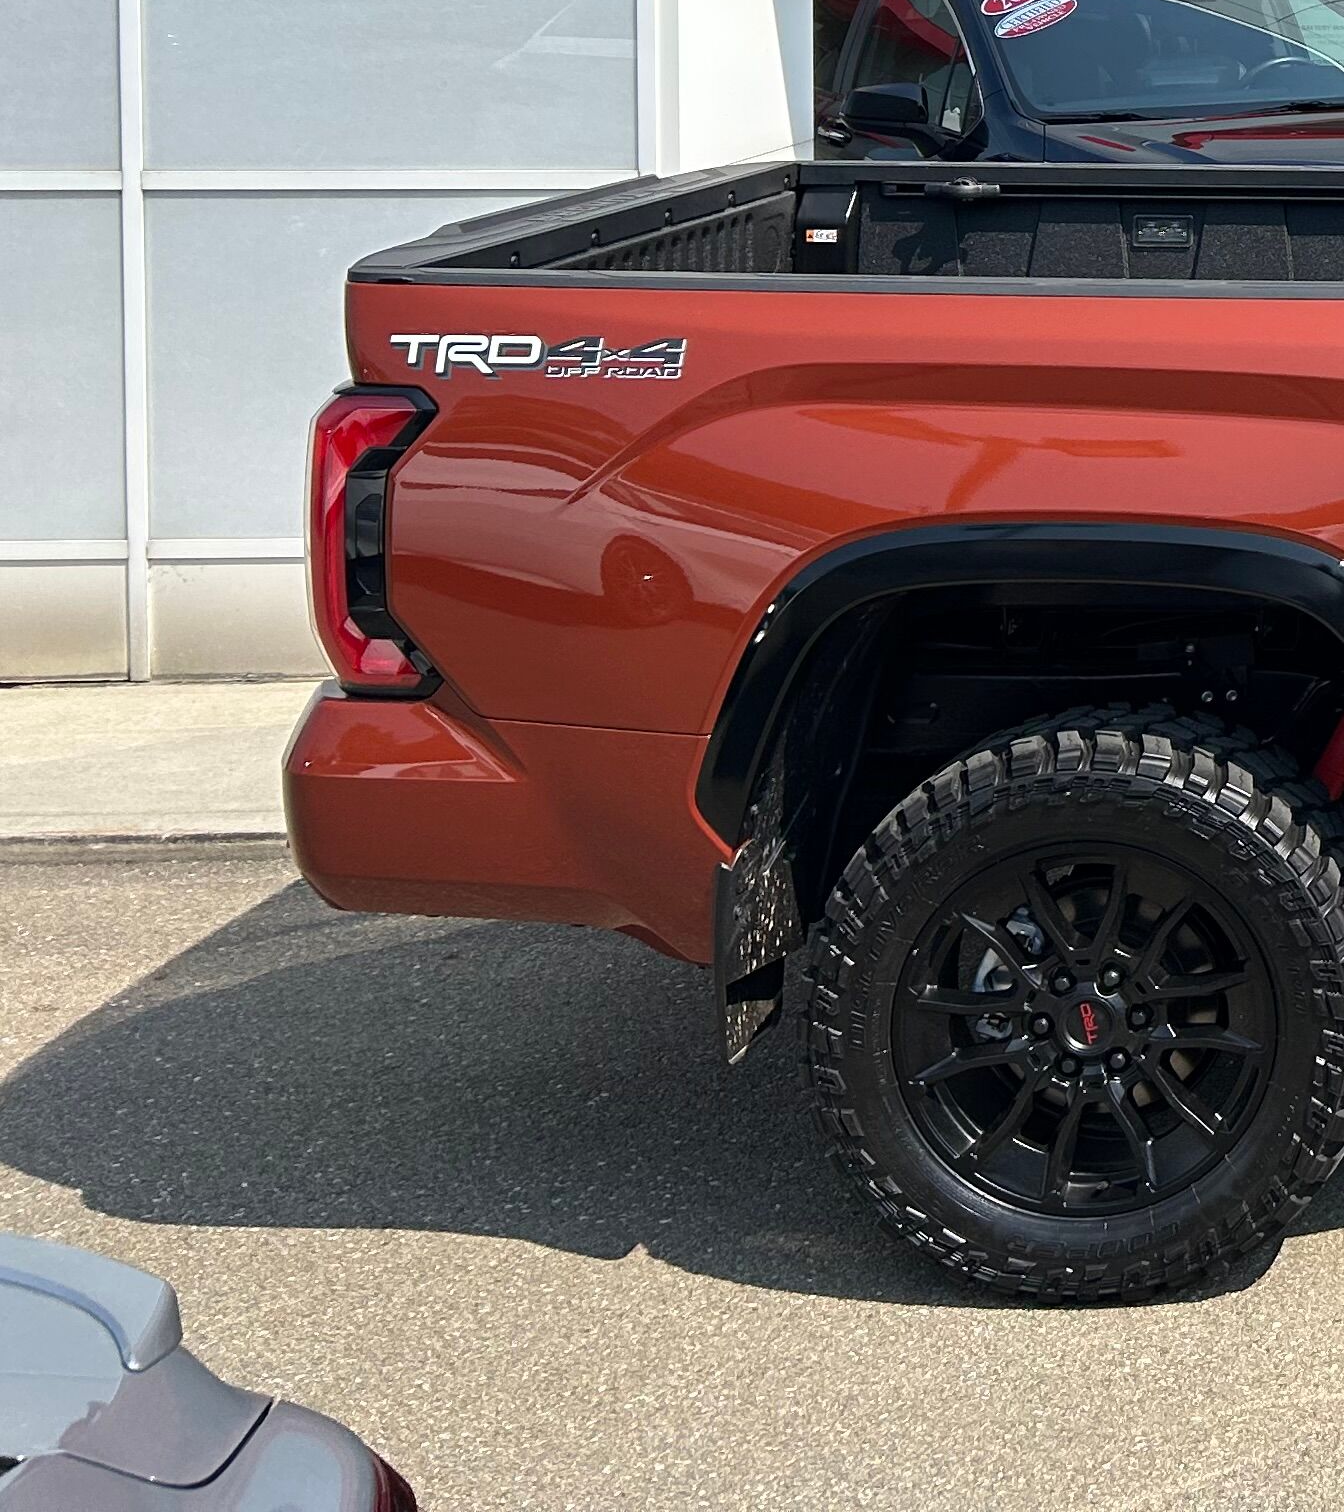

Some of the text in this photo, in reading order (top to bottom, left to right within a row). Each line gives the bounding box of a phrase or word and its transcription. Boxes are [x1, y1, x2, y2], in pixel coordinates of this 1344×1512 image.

[389, 334, 546, 378] TRD
[545, 366, 682, 379] OFF ROAD
[1080, 1003, 1098, 1045] TRD
